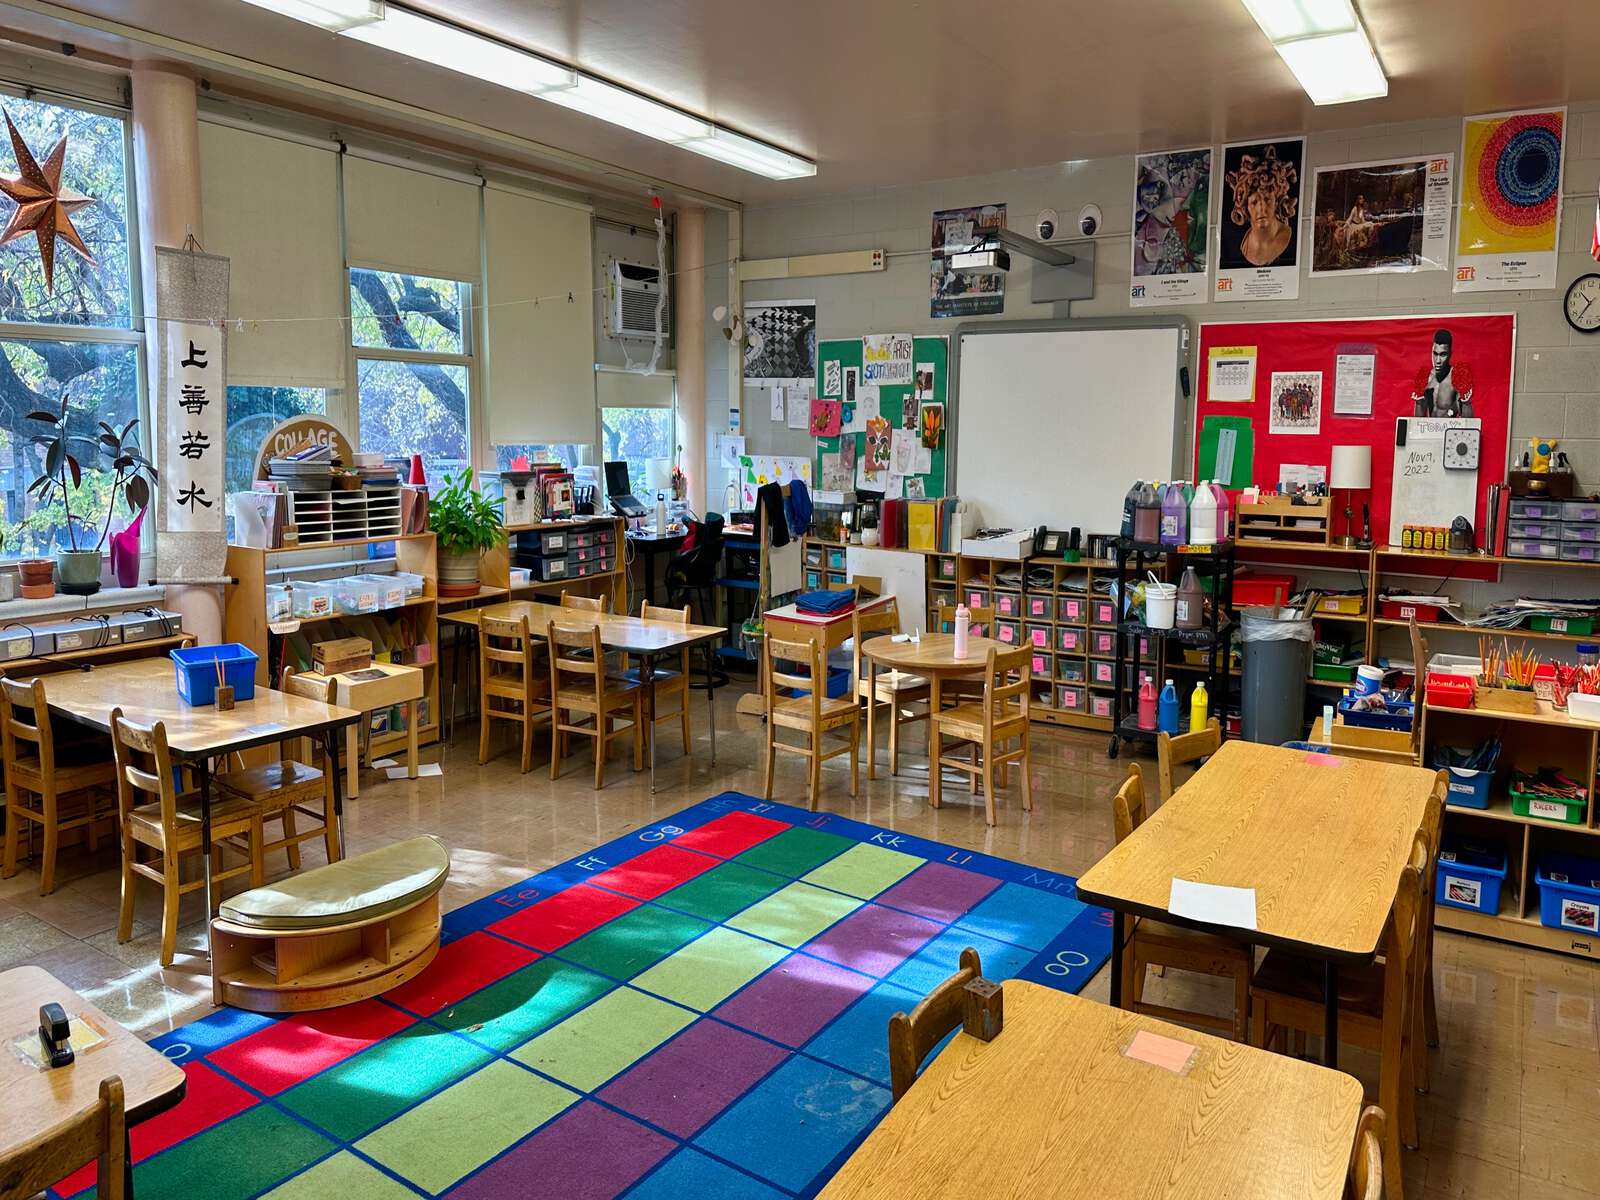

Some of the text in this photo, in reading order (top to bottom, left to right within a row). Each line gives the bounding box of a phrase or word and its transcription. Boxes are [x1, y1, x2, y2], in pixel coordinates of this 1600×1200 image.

[1430, 160, 1448, 173] art
[1456, 267, 1476, 281] art
[1131, 286, 1145, 297] art
[1217, 278, 1232, 290] art
[176, 339, 213, 514] 上善若水
[1404, 465, 1431, 476] 2022
[703, 798, 738, 813] Hh
[639, 825, 684, 842] Gg
[870, 832, 905, 848] Kk
[575, 855, 608, 871] Ff
[495, 888, 540, 908] Ee
[1043, 950, 1090, 976] Oo
